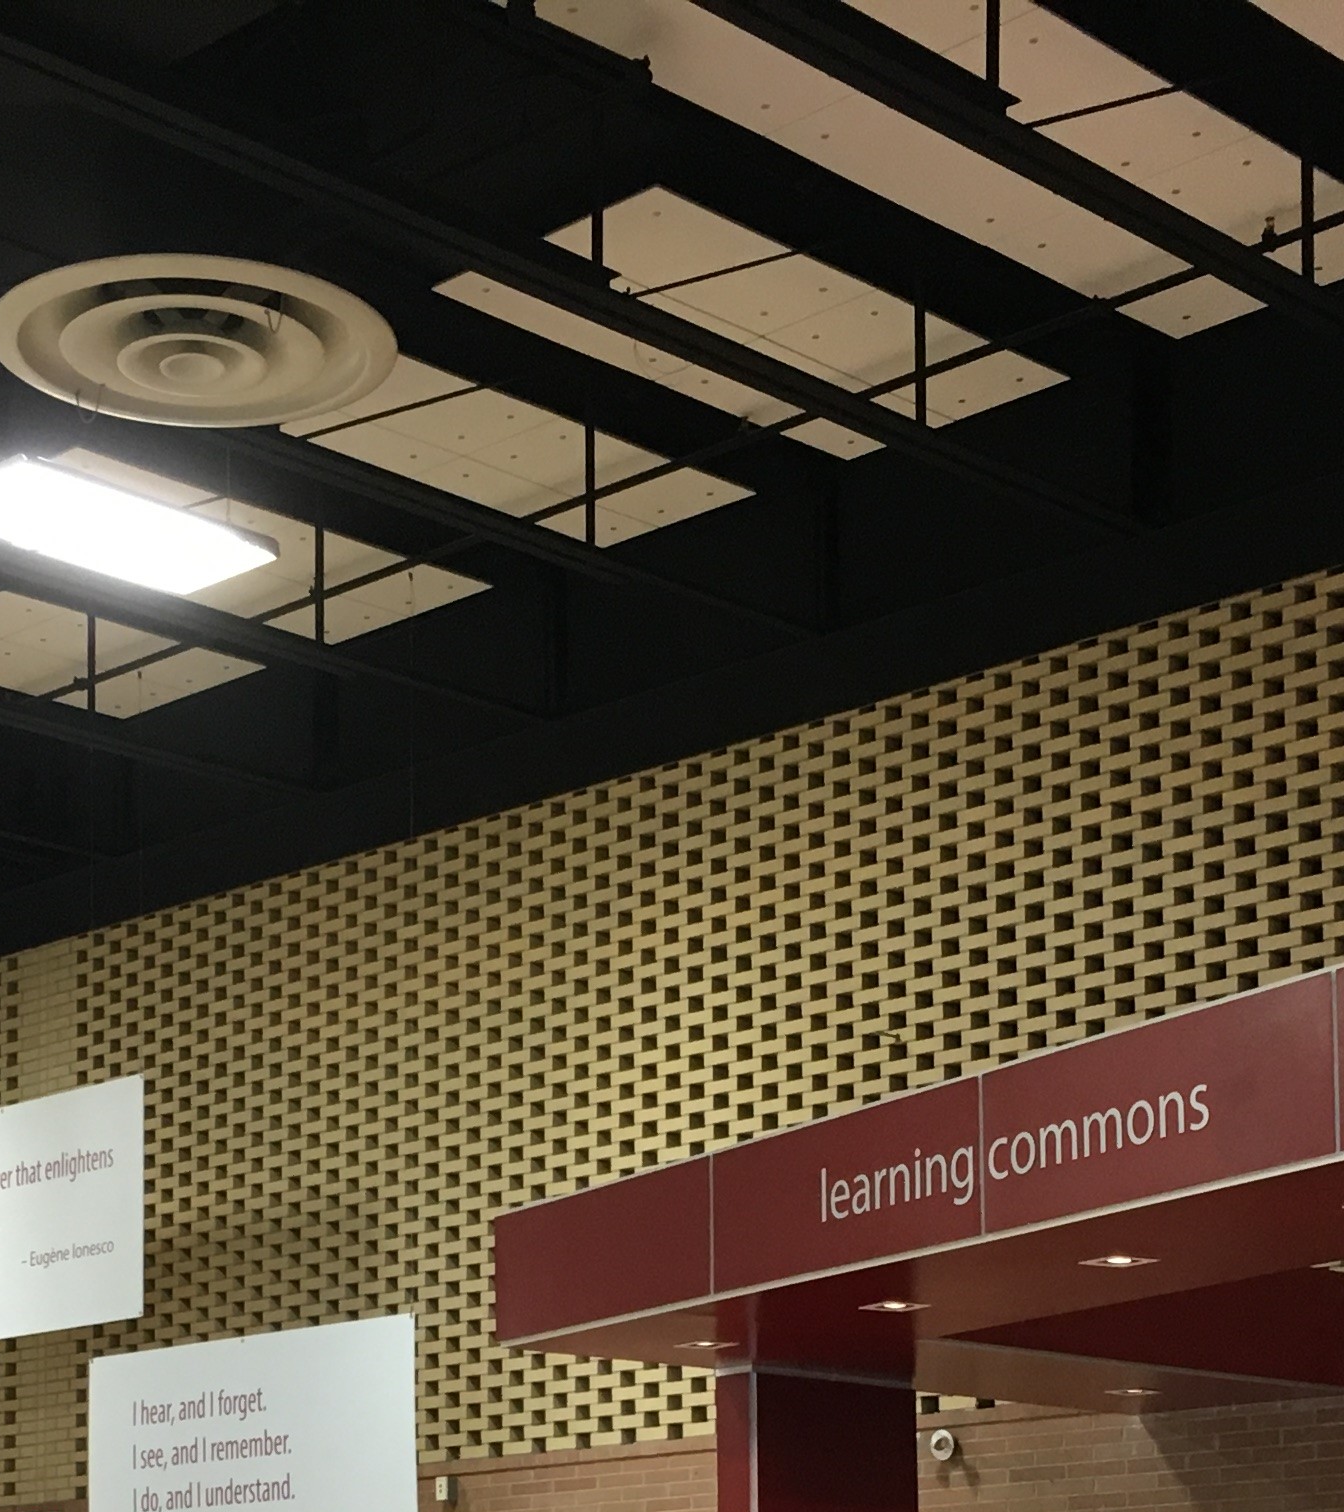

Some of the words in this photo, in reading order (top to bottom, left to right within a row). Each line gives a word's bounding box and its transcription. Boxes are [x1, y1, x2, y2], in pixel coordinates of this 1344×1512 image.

[15, 1160, 42, 1188] that
[45, 1148, 115, 1182] enlightens
[821, 1145, 974, 1223] learning
[988, 1083, 1210, 1180] commons
[29, 1247, 70, 1269] Eugène
[72, 1239, 115, 1260] Ionesco
[140, 1399, 175, 1426] hear,
[178, 1391, 206, 1421] and
[217, 1387, 267, 1421] forget.
[140, 1447, 168, 1471] see,
[171, 1436, 198, 1466] and
[210, 1429, 292, 1462] remember.
[165, 1482, 193, 1511] and
[205, 1472, 296, 1507] understand.
